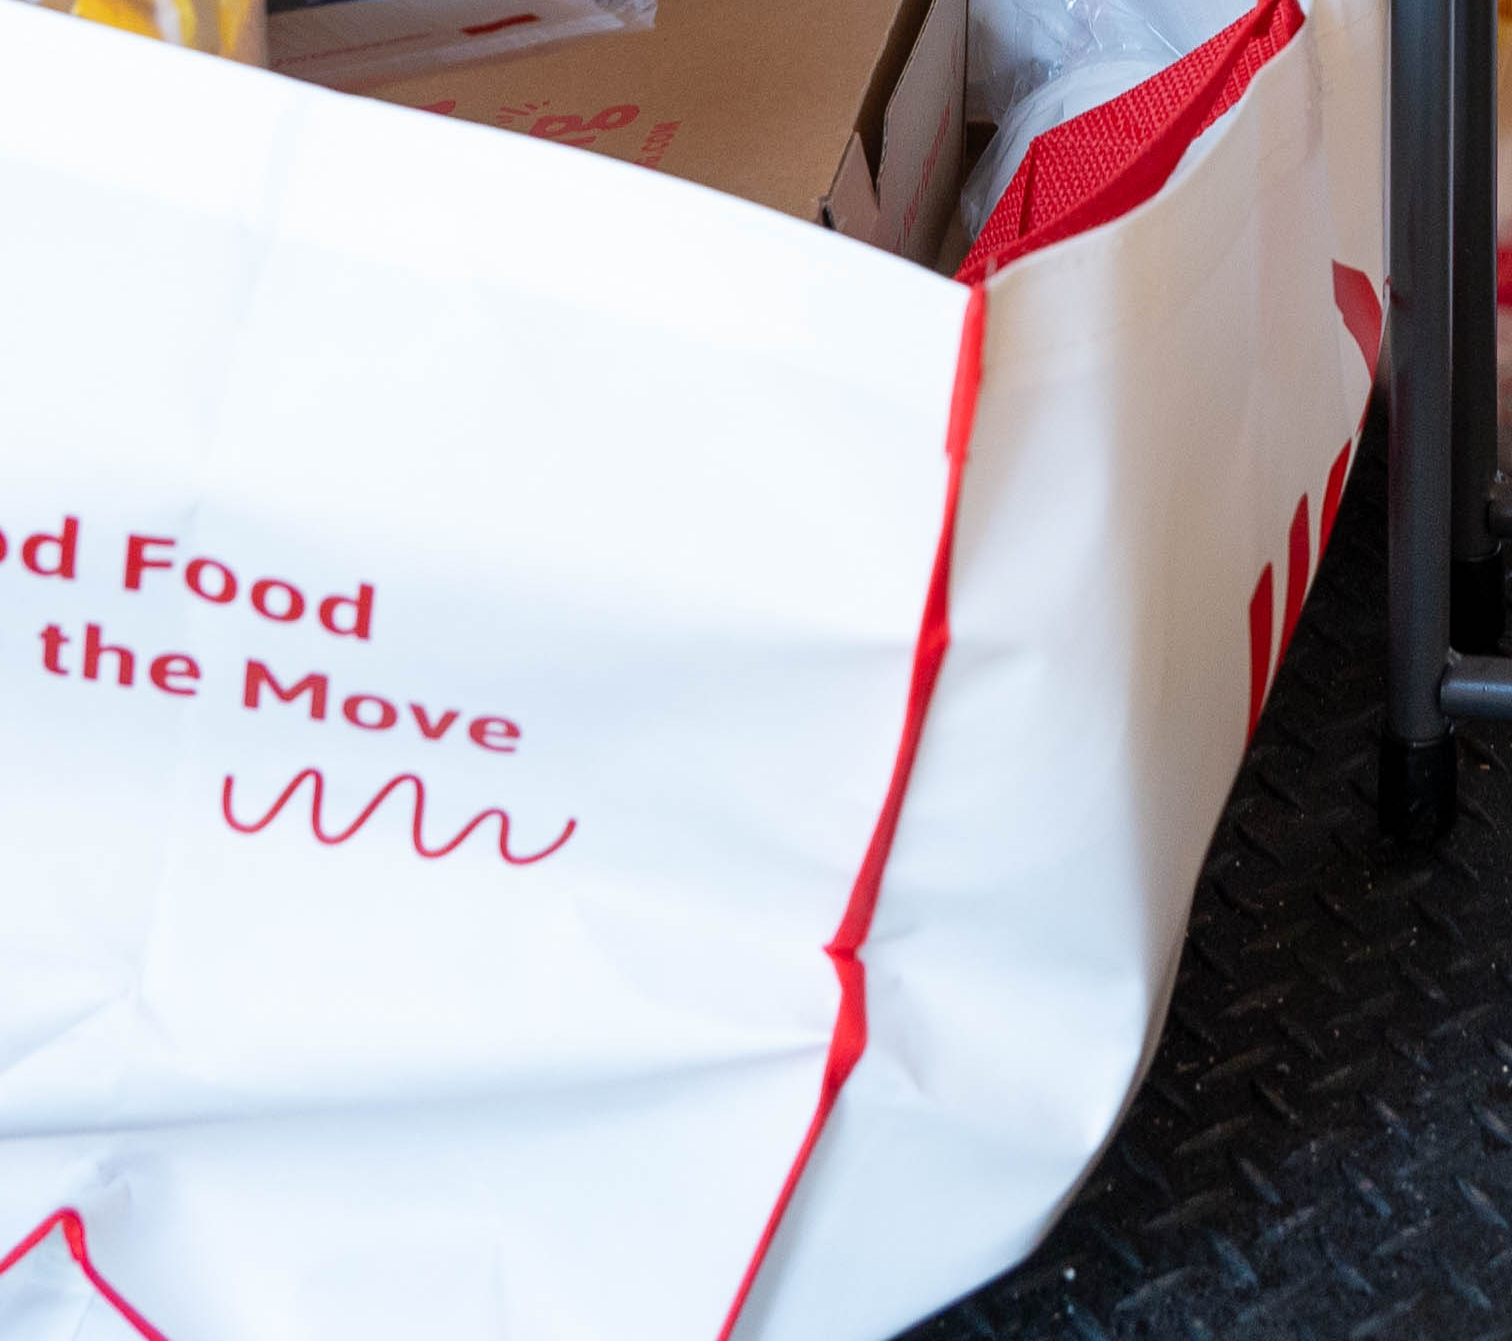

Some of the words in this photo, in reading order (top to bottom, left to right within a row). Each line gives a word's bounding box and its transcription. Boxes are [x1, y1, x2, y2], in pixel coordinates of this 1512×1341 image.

[124, 534, 375, 640] Food
[41, 624, 202, 696] the
[243, 659, 523, 754] Move
